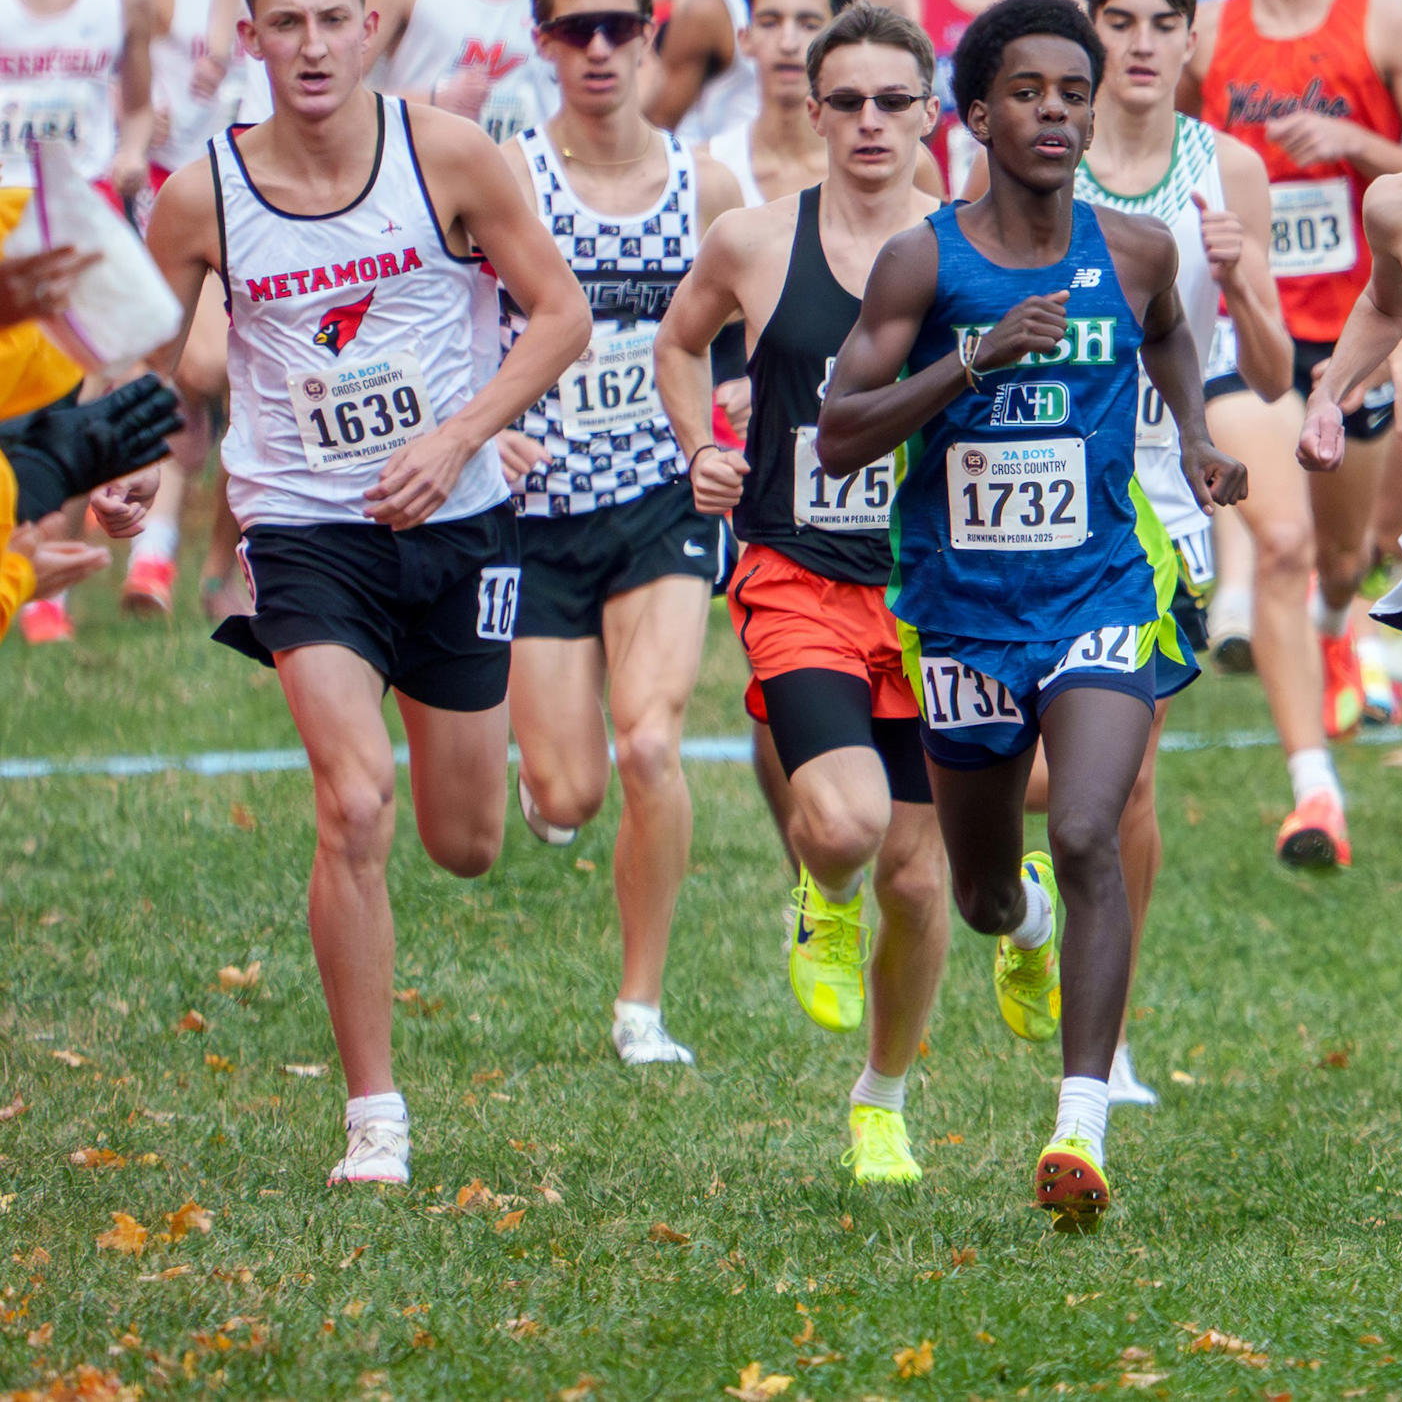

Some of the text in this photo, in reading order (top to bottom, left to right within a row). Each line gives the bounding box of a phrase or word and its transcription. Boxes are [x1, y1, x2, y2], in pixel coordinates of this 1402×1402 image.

[1271, 215, 1340, 254] 803
[246, 247, 423, 303] METAMORA
[331, 370, 404, 398] CROSS COUNTRY
[338, 362, 391, 383] 2A BOYS
[573, 365, 656, 413] 162
[310, 386, 422, 448] 1639
[990, 383, 1007, 426] PEORIA
[362, 443, 388, 456] PEORIA
[1001, 448, 1055, 461] 2A BOYS
[991, 460, 1067, 476] CROSS COUNTRY
[809, 465, 890, 509] 175
[962, 479, 1077, 528] 1732
[810, 514, 890, 524] RUNNING IN PEORIA 202
[967, 533, 997, 543] RUNNING
[998, 534, 1006, 543] IN
[1007, 534, 1033, 543] PEORIA
[1034, 533, 1053, 543] 2025
